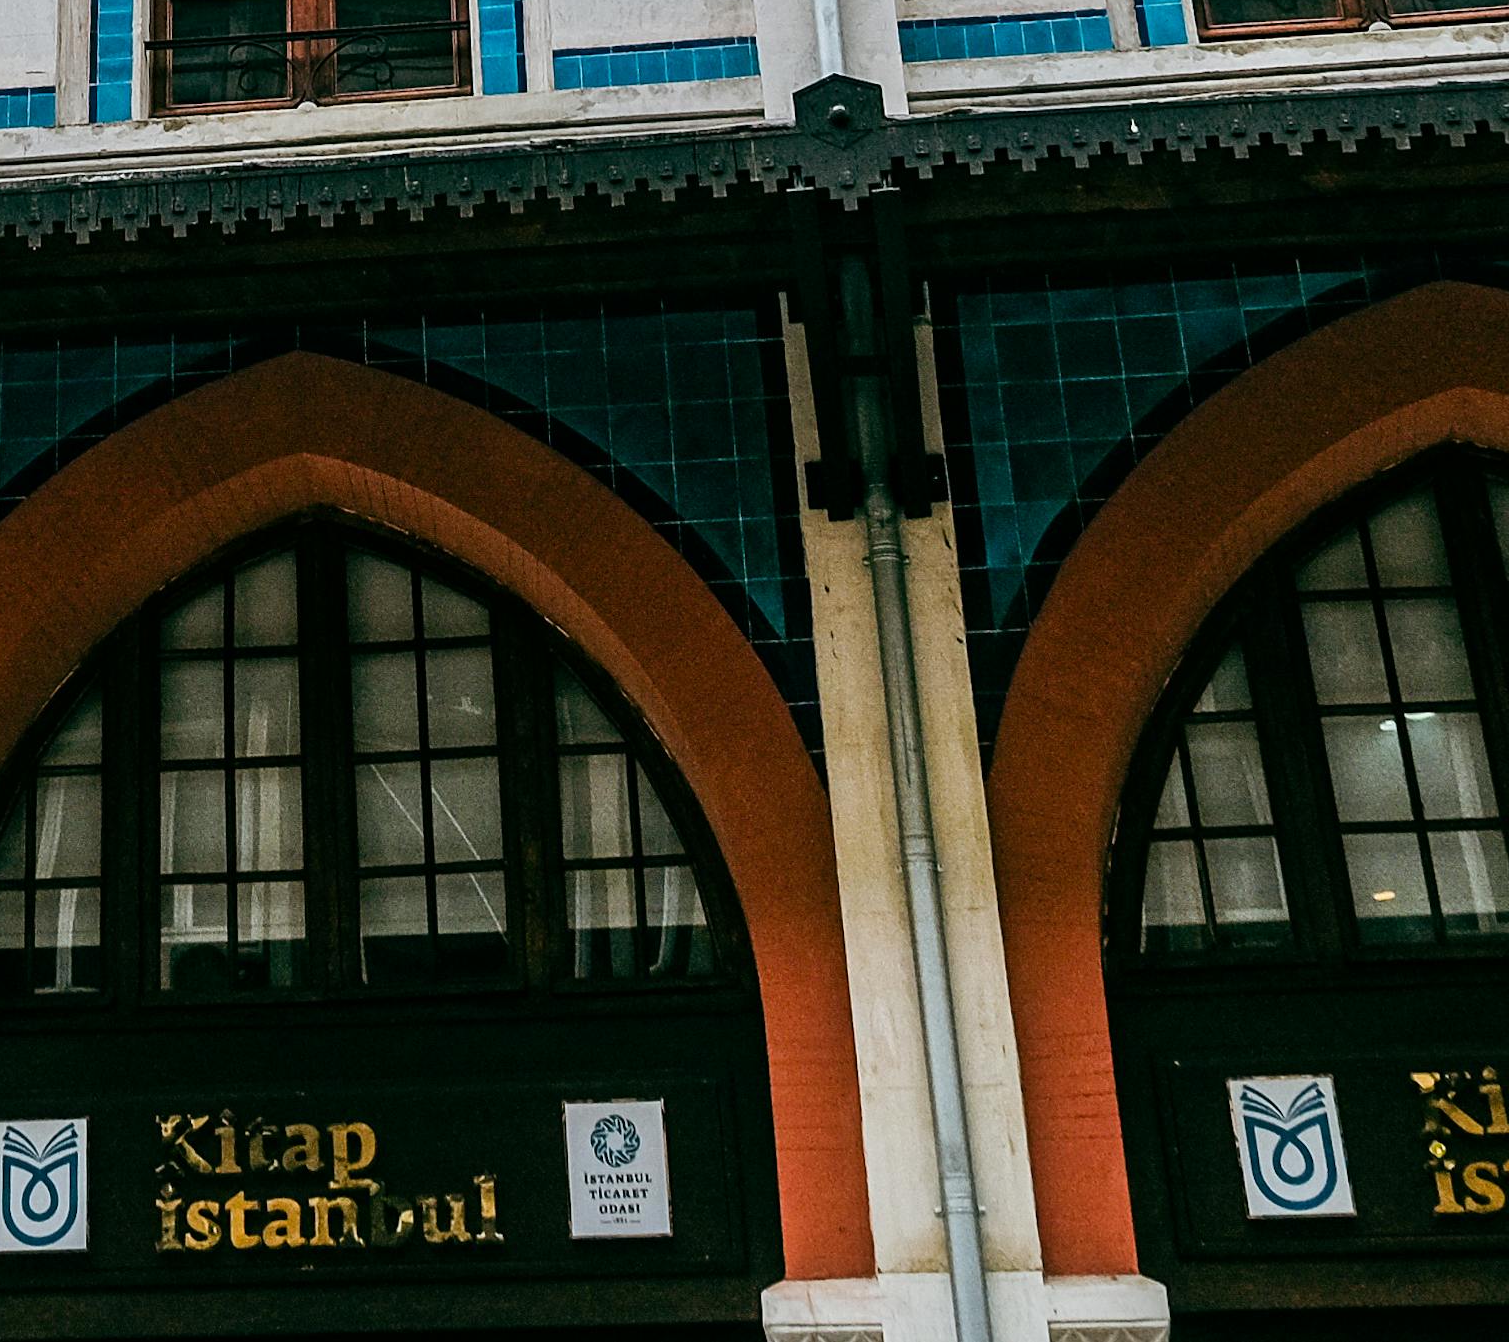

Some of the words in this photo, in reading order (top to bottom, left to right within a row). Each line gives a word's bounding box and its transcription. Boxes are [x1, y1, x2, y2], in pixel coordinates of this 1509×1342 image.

[155, 1108, 380, 1190] Kitap
[584, 1171, 653, 1185] İSTANBUL
[588, 1186, 650, 1201] TİCARET
[155, 1170, 505, 1252] istanbul
[598, 1203, 641, 1215] ODASI
